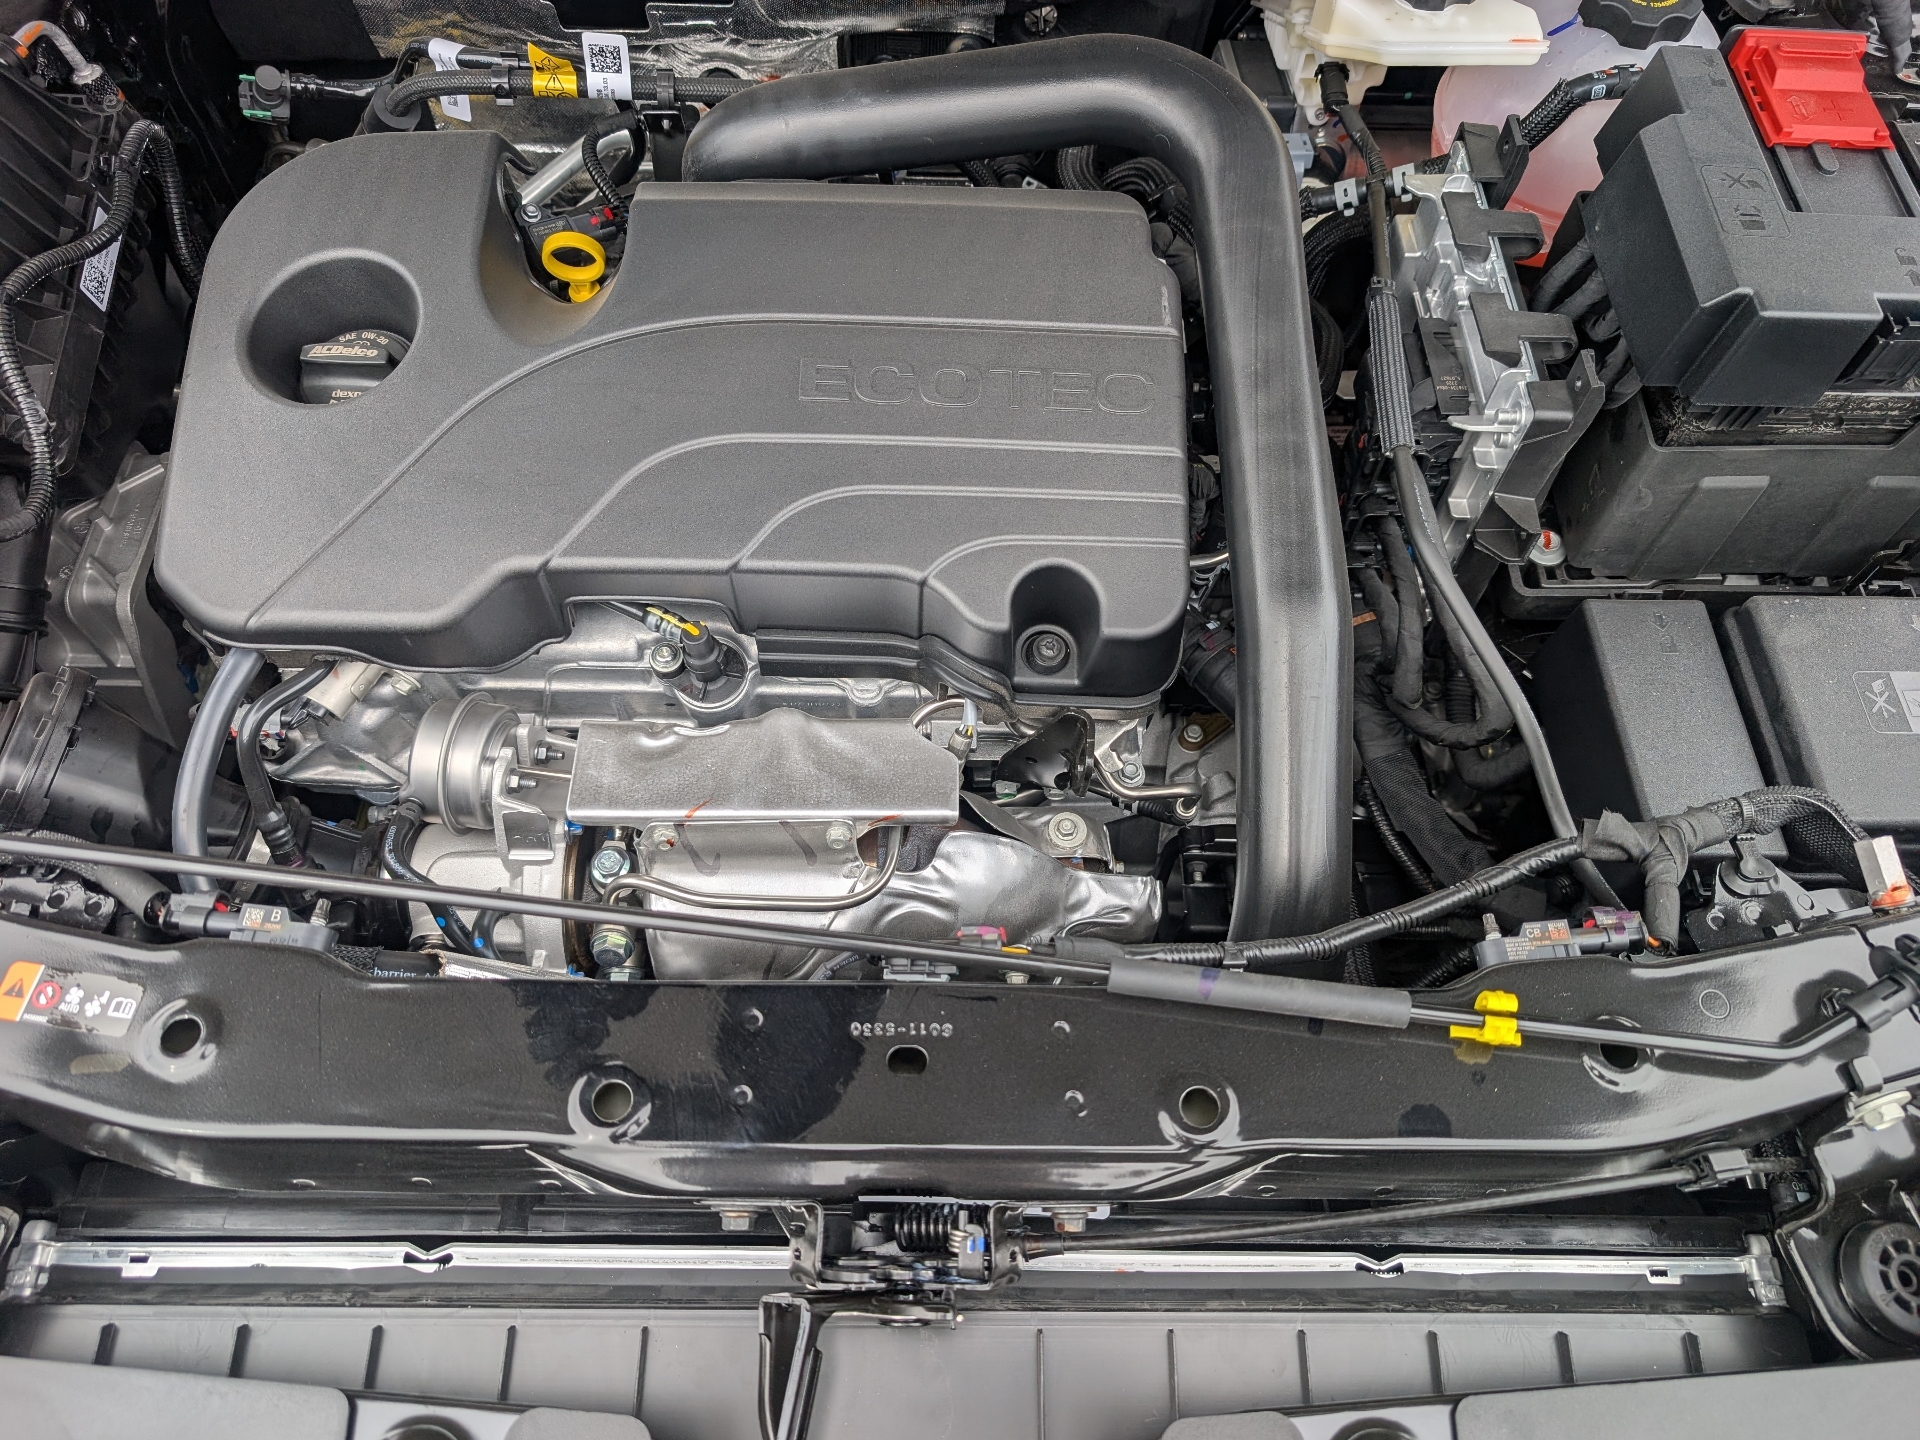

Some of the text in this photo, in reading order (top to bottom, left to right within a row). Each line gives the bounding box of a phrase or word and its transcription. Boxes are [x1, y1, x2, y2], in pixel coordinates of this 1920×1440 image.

[339, 331, 389, 345] SAE 0W-20
[307, 345, 379, 358] ACDelco
[798, 357, 1154, 415] ECOTEC
[270, 908, 282, 922] B
[1525, 928, 1542, 938] CB
[373, 966, 417, 979] barrier
[58, 1001, 80, 1014] AUTO
